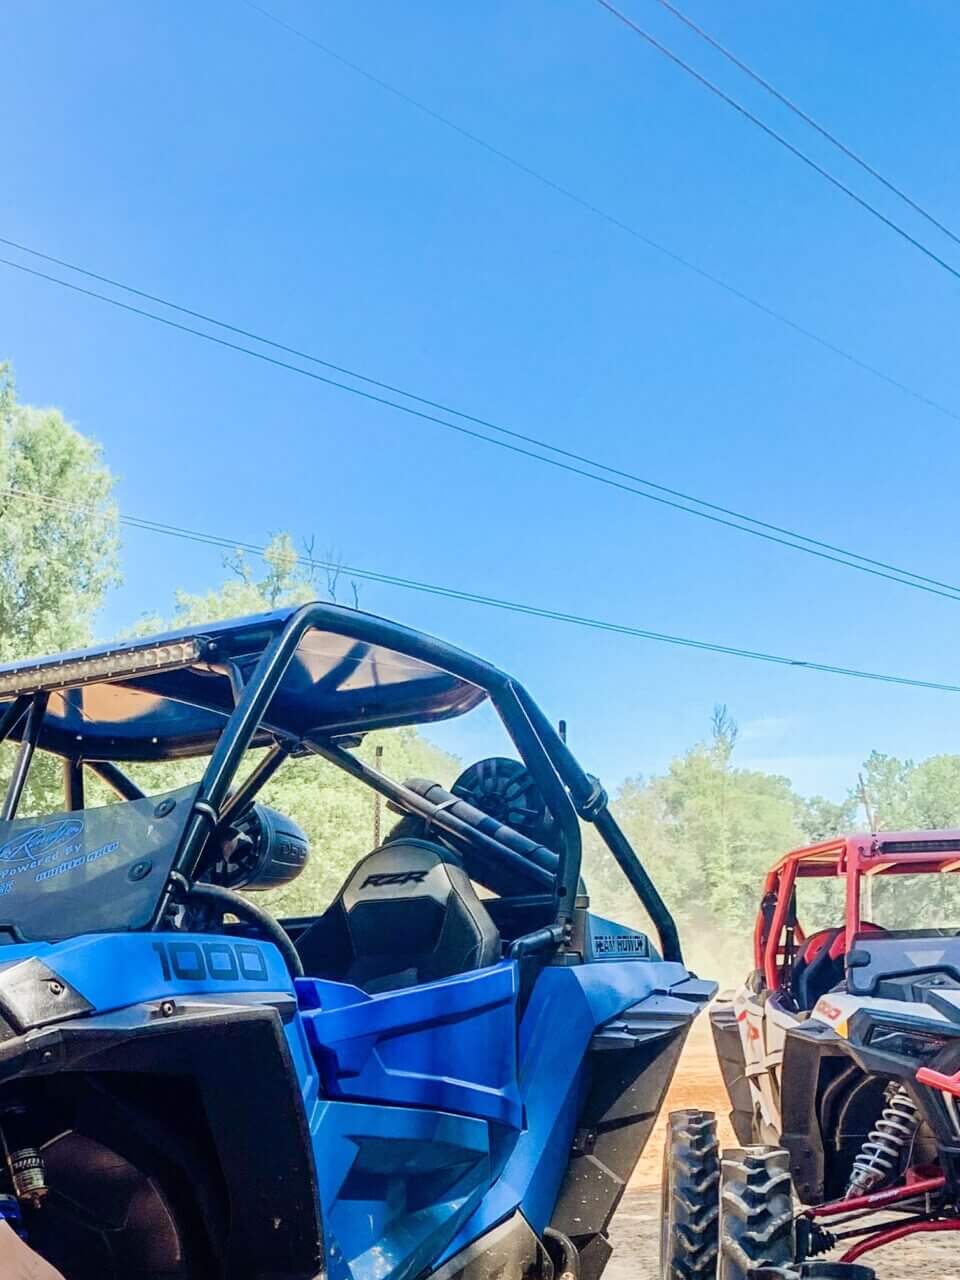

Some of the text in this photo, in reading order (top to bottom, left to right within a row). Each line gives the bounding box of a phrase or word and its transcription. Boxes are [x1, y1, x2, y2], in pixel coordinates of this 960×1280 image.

[0, 851, 59, 879] Powered
[358, 870, 429, 890] RZR
[152, 941, 269, 982] 1000
